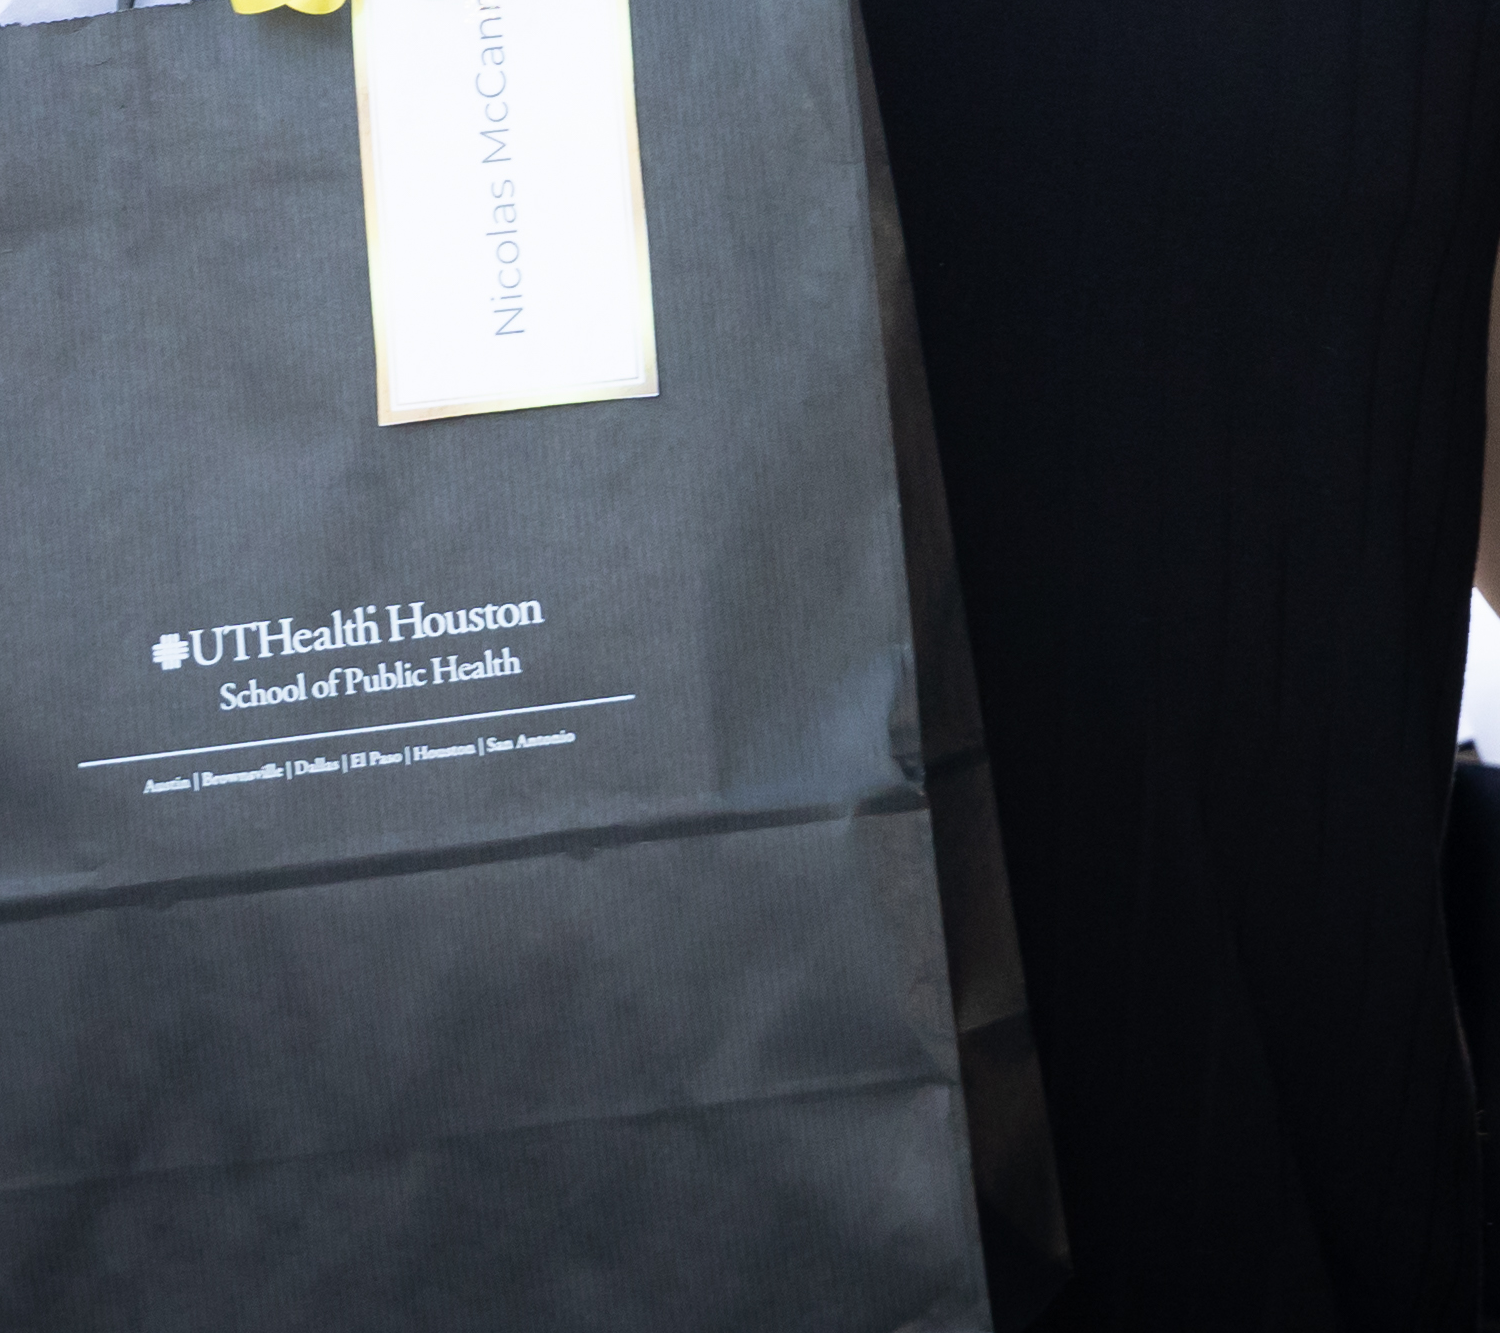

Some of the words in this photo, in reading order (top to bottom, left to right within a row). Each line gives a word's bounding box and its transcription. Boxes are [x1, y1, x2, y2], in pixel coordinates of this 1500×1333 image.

[486, 179, 526, 336] Nicolas
[188, 605, 382, 666] UTHealth
[385, 599, 545, 643] Houston
[220, 673, 306, 711] School
[311, 668, 343, 699] of
[343, 661, 428, 695] Public
[430, 647, 524, 684] Health
